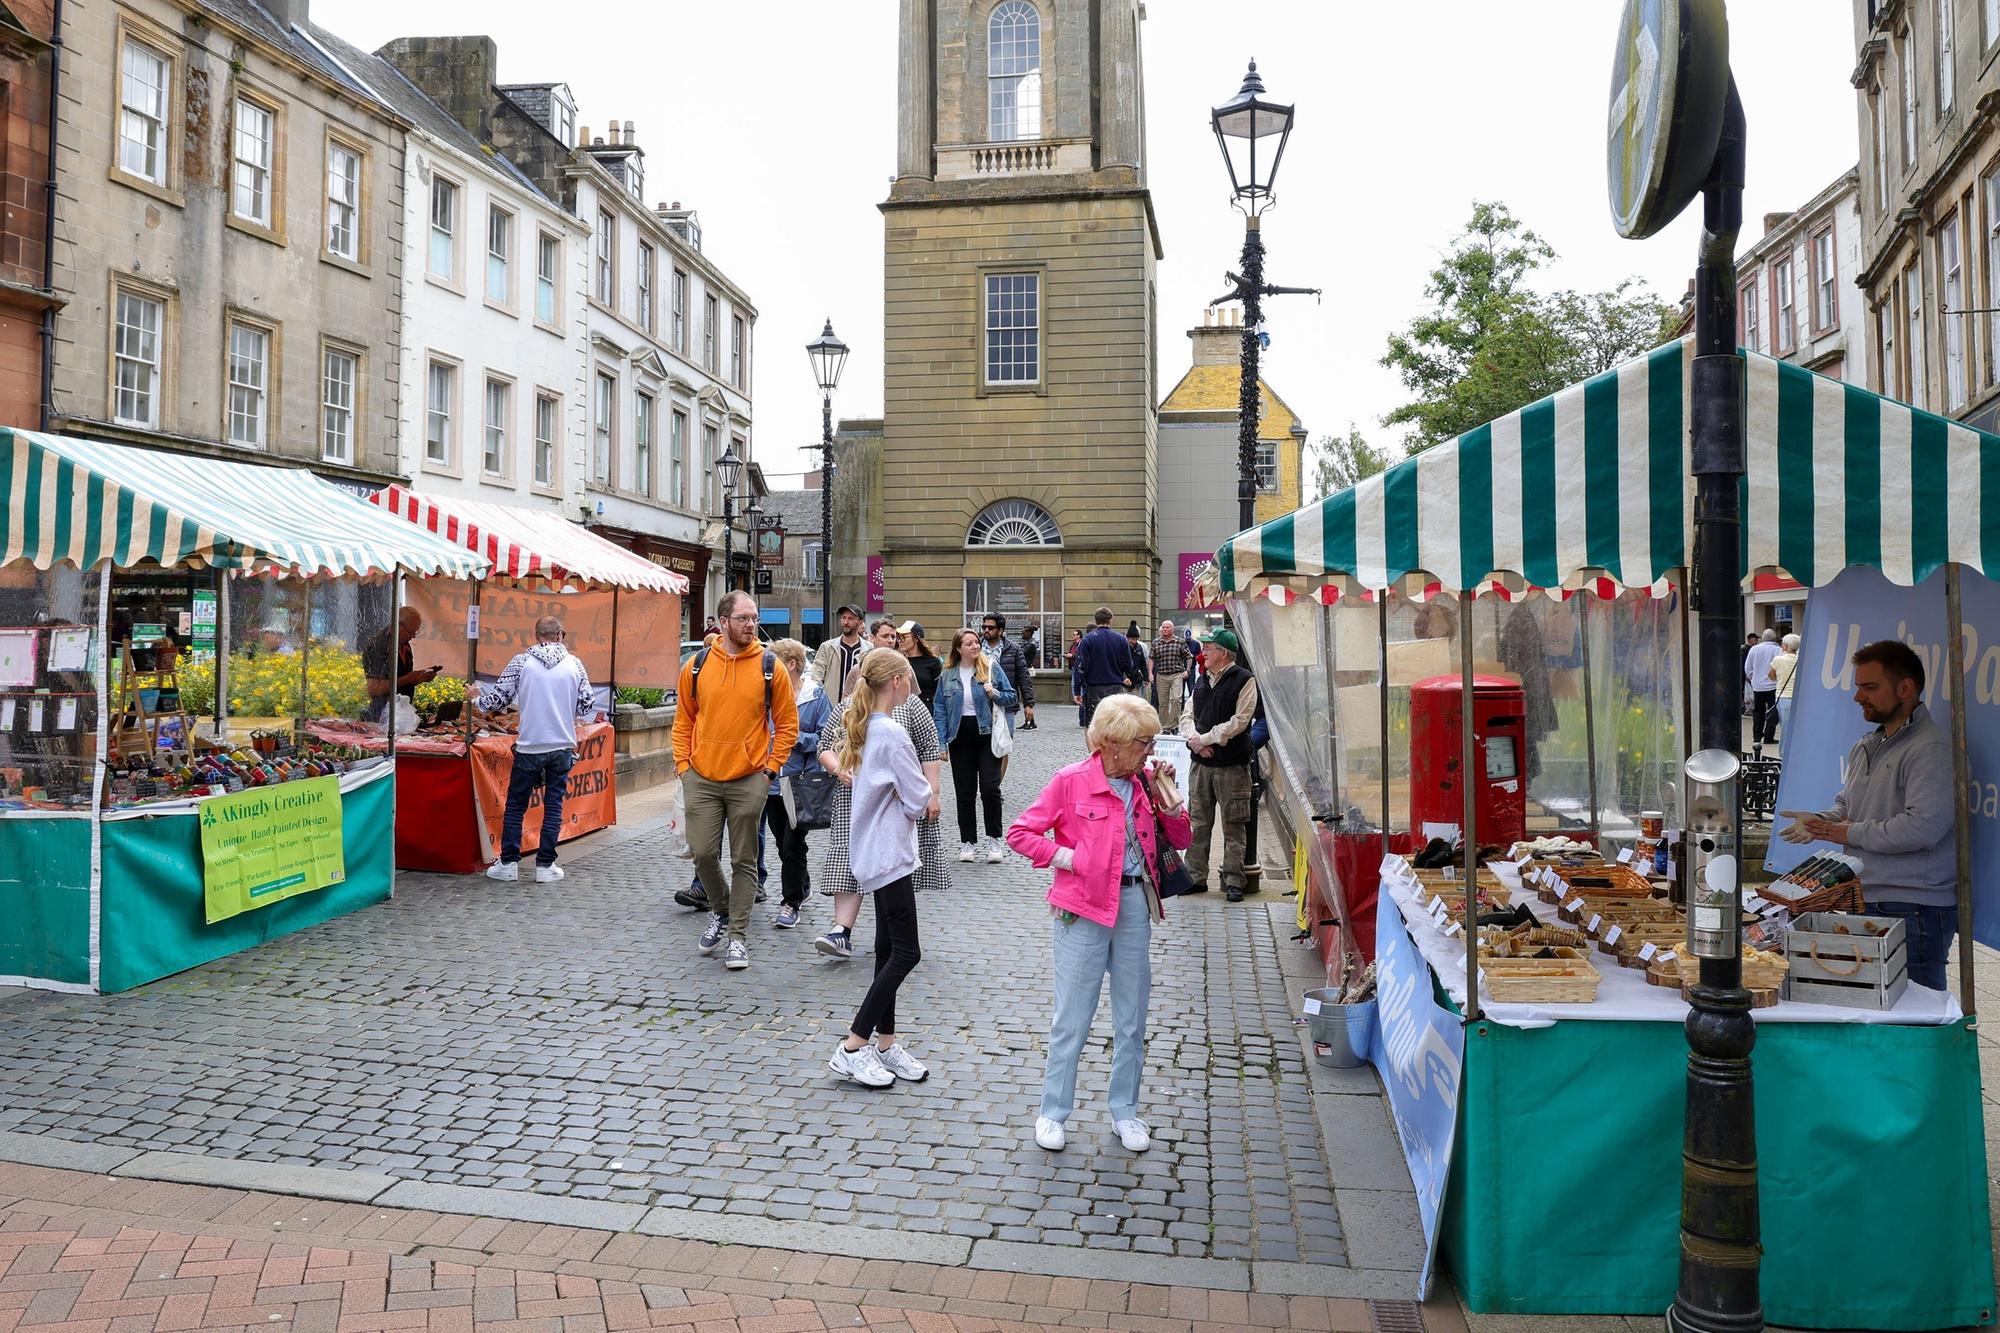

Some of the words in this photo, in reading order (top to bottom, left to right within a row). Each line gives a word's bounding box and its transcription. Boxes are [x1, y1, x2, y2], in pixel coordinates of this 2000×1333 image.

[220, 799, 271, 824] AKingly
[274, 790, 323, 812] Creative
[217, 834, 247, 850] Unique
[251, 827, 271, 841] Hand
[273, 820, 301, 835] Painted
[302, 815, 328, 827] Design
